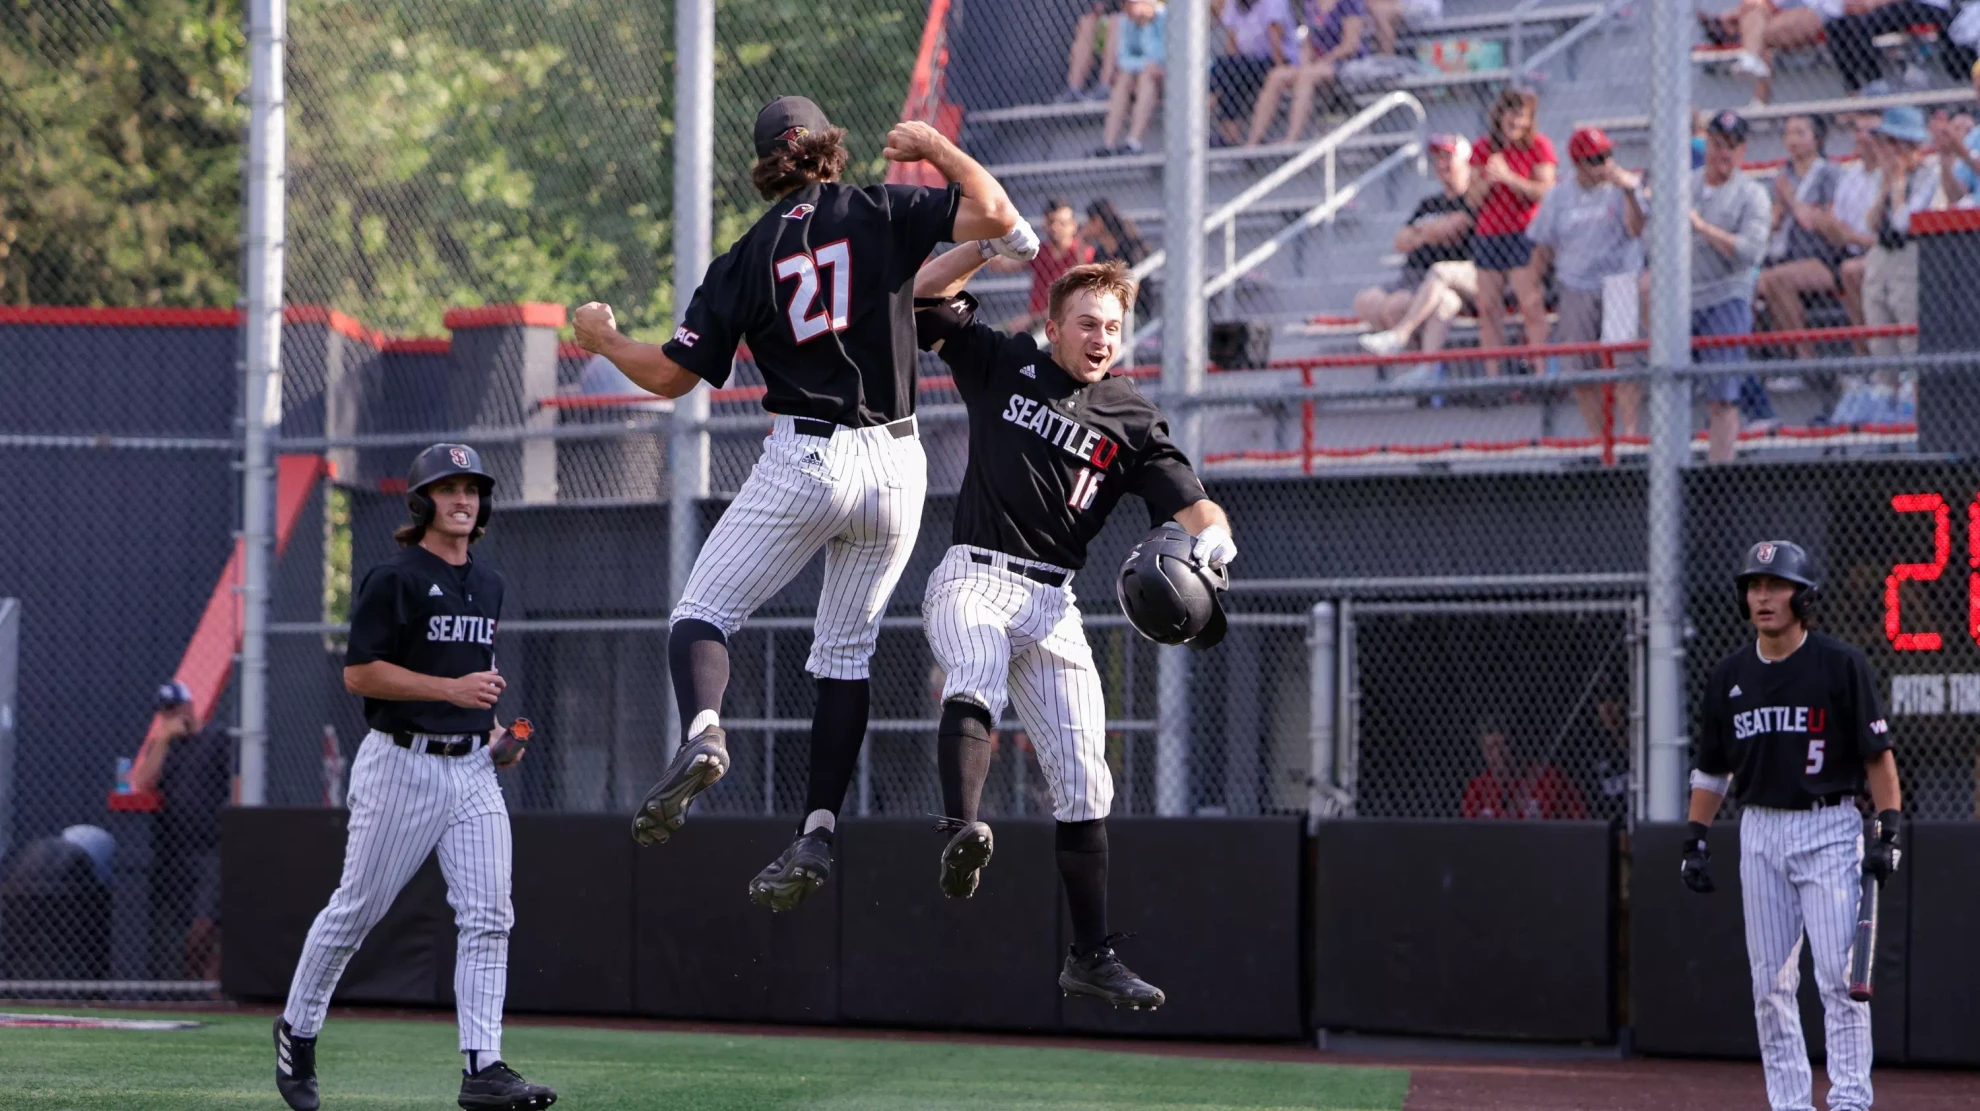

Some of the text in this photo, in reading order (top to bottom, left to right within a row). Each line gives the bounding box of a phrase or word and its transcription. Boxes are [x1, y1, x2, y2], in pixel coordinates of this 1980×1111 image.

[775, 238, 852, 346] 27
[1002, 393, 1119, 469] SEATTLEU
[1885, 492, 1980, 651] 2
[426, 615, 498, 645] SEATTLE
[1733, 706, 1825, 739] SEATTLEU
[1805, 739, 1825, 775] 5
